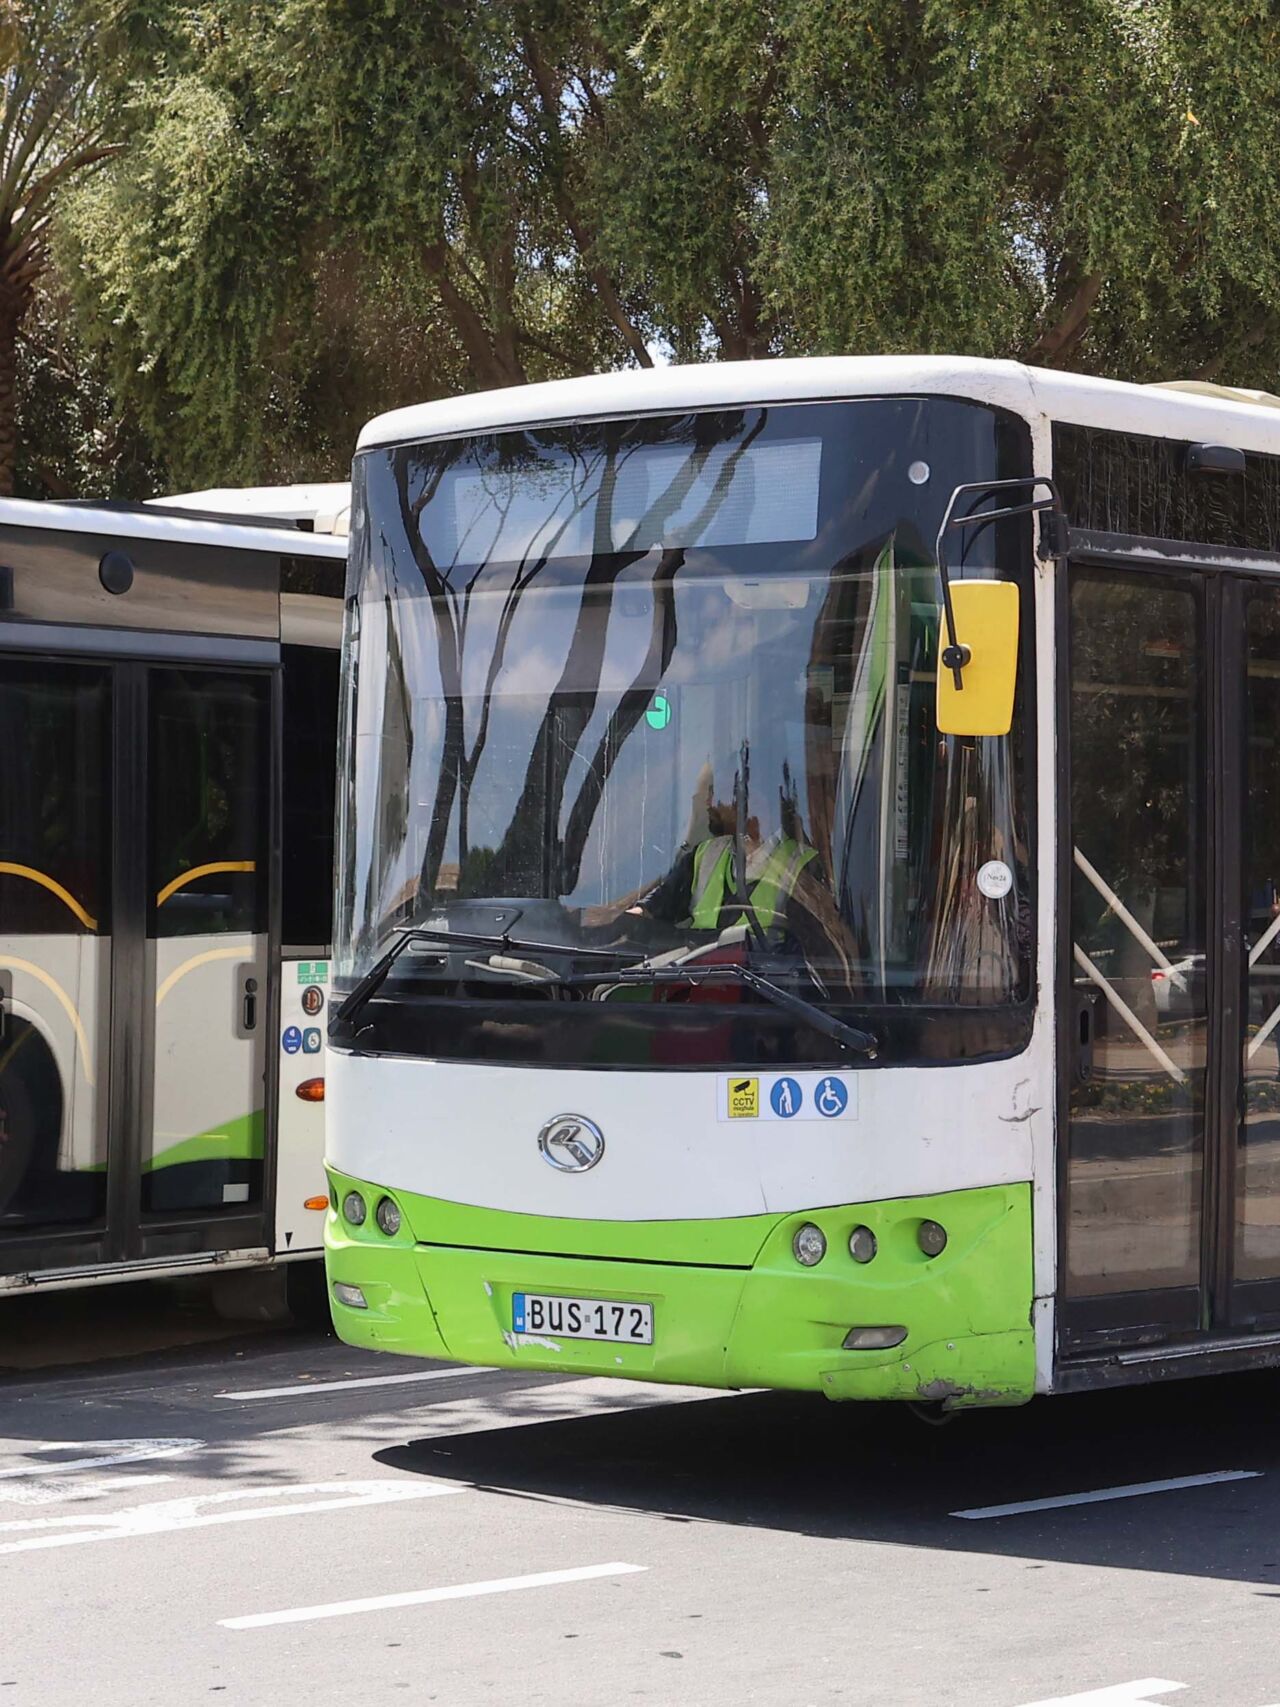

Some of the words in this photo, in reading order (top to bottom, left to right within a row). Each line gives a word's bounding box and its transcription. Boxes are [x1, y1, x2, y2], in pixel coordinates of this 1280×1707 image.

[733, 1098, 755, 1106] CCTV
[531, 1300, 582, 1333] BUS
[595, 1306, 644, 1338] 172
